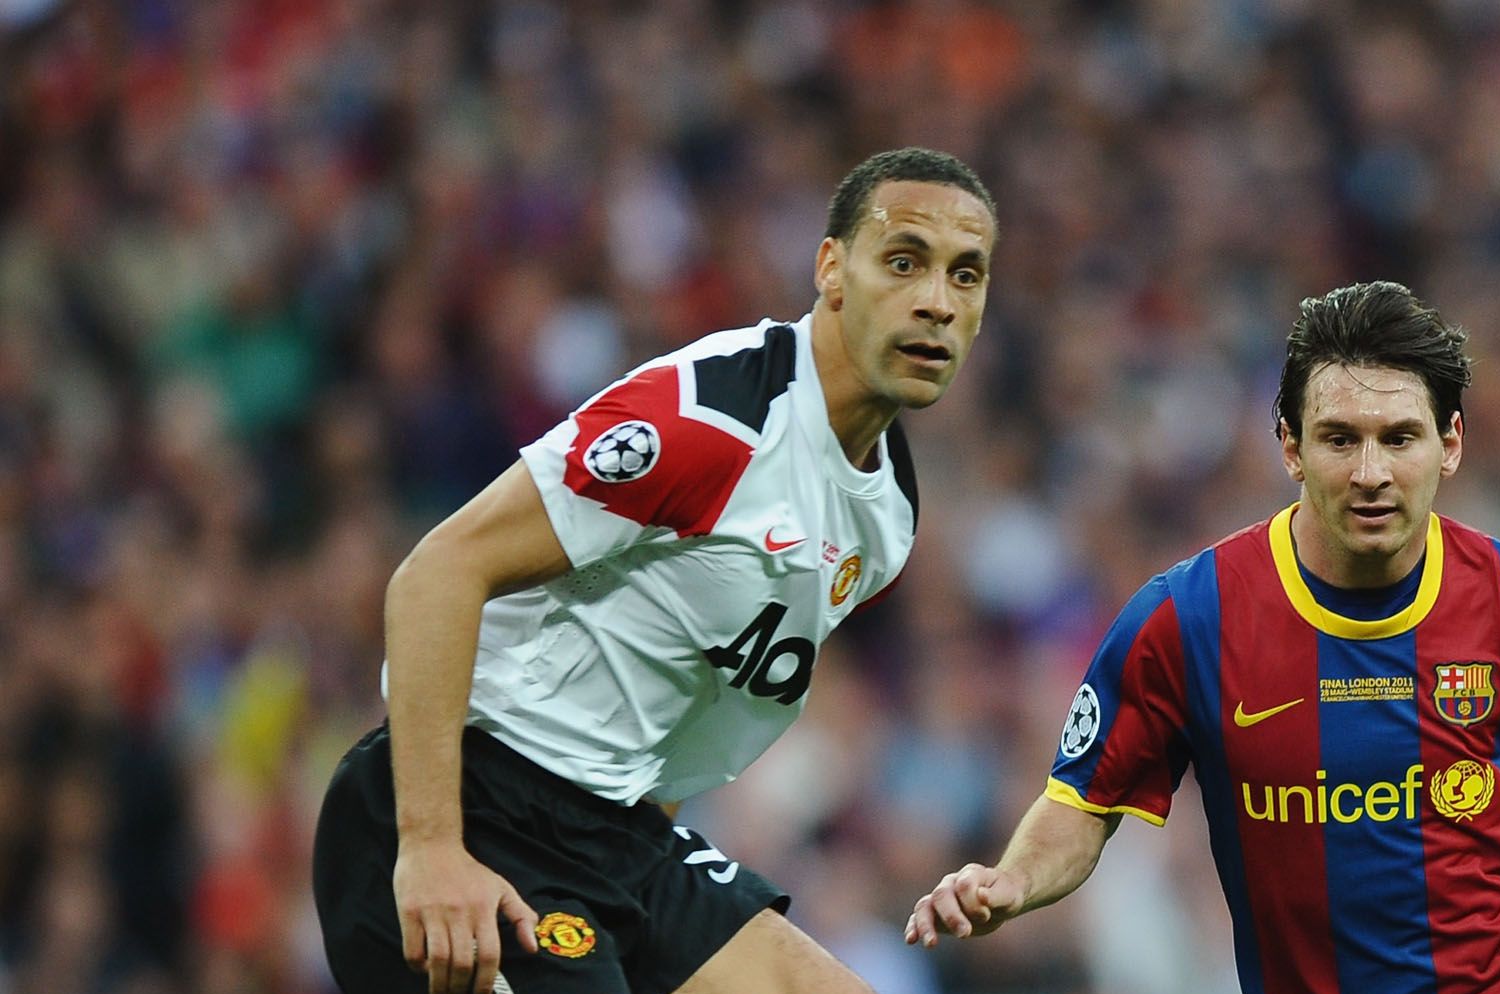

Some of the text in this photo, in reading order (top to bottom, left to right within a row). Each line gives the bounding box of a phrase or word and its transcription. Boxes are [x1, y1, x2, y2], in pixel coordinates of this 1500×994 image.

[1320, 677, 1413, 688] FINAL LONDON 2011
[1242, 764, 1424, 823] unicef
